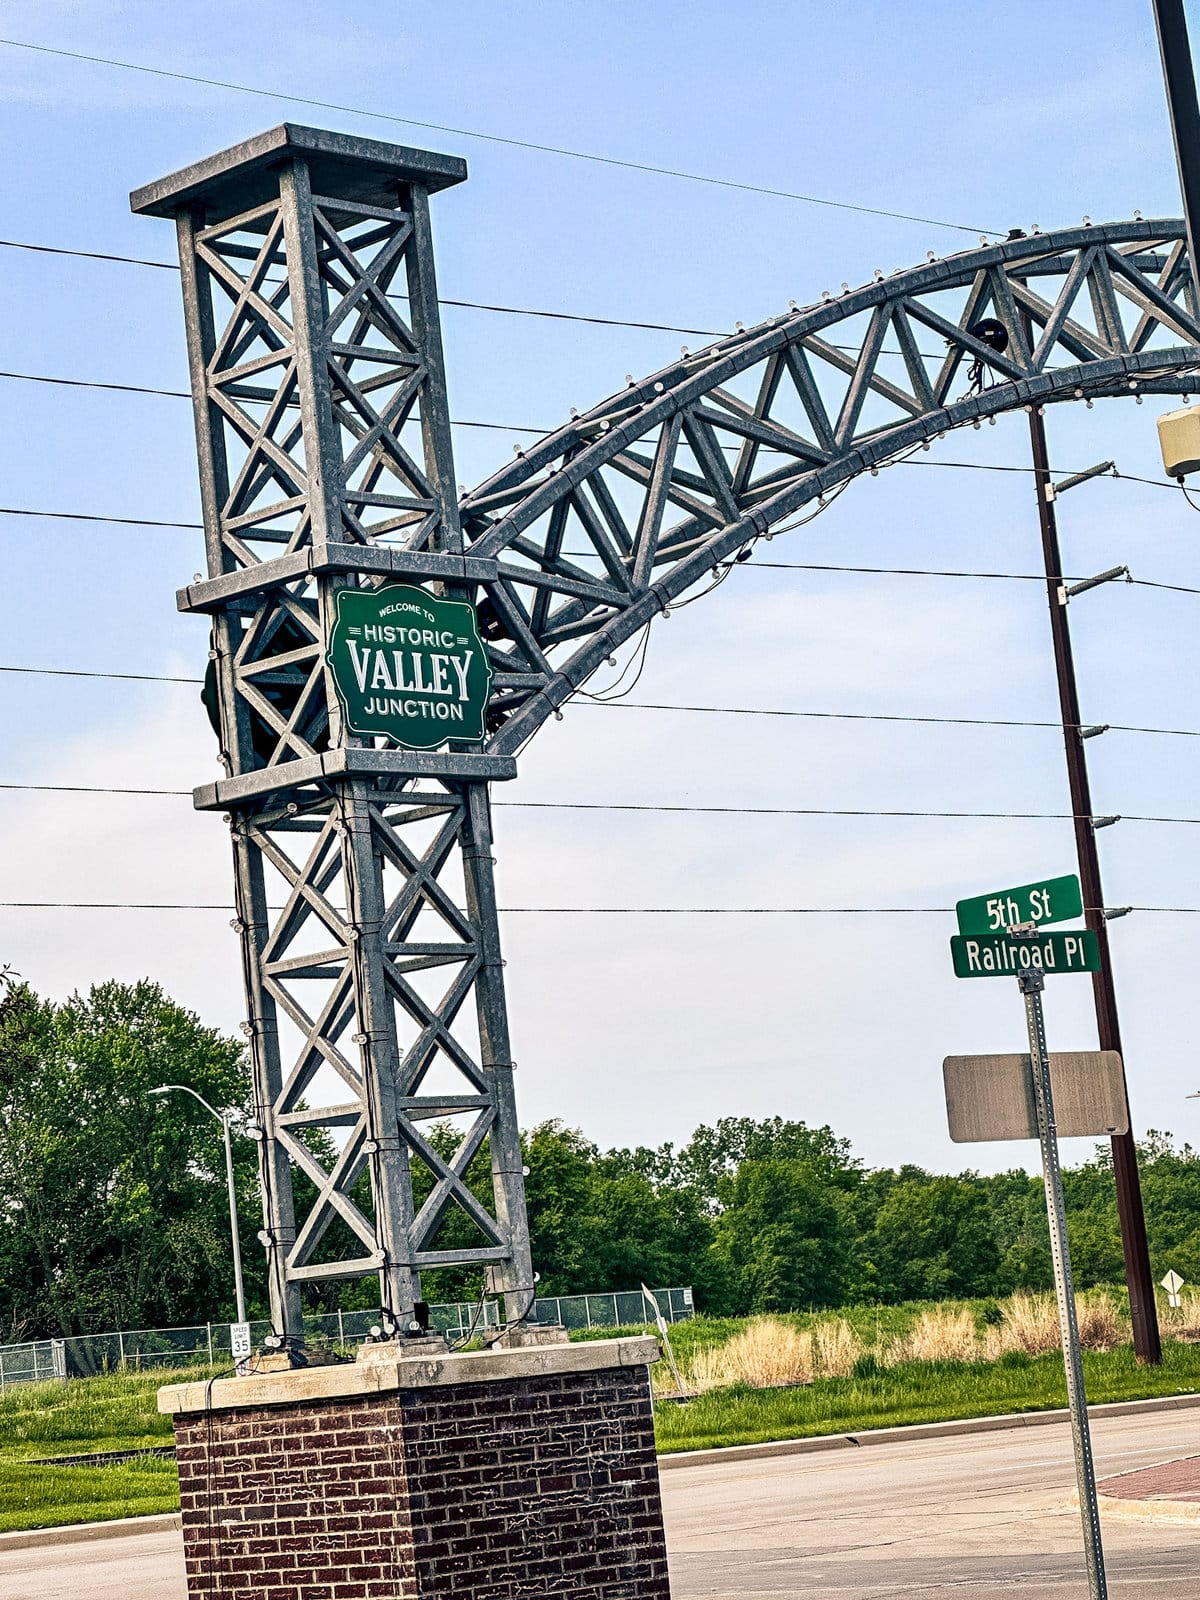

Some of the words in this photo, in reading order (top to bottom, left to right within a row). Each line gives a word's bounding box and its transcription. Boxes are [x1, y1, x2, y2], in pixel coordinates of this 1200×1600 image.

[379, 603, 421, 618] WELCOME
[422, 608, 435, 623] TO
[364, 624, 454, 648] HISTORIC
[345, 639, 474, 701] VALLEY
[364, 697, 464, 721] JUNCTION
[986, 897, 1021, 930] 5th
[1029, 888, 1052, 921] St
[966, 938, 1056, 971] Railroad
[1064, 937, 1086, 967] Pl
[234, 1340, 249, 1352] 35
